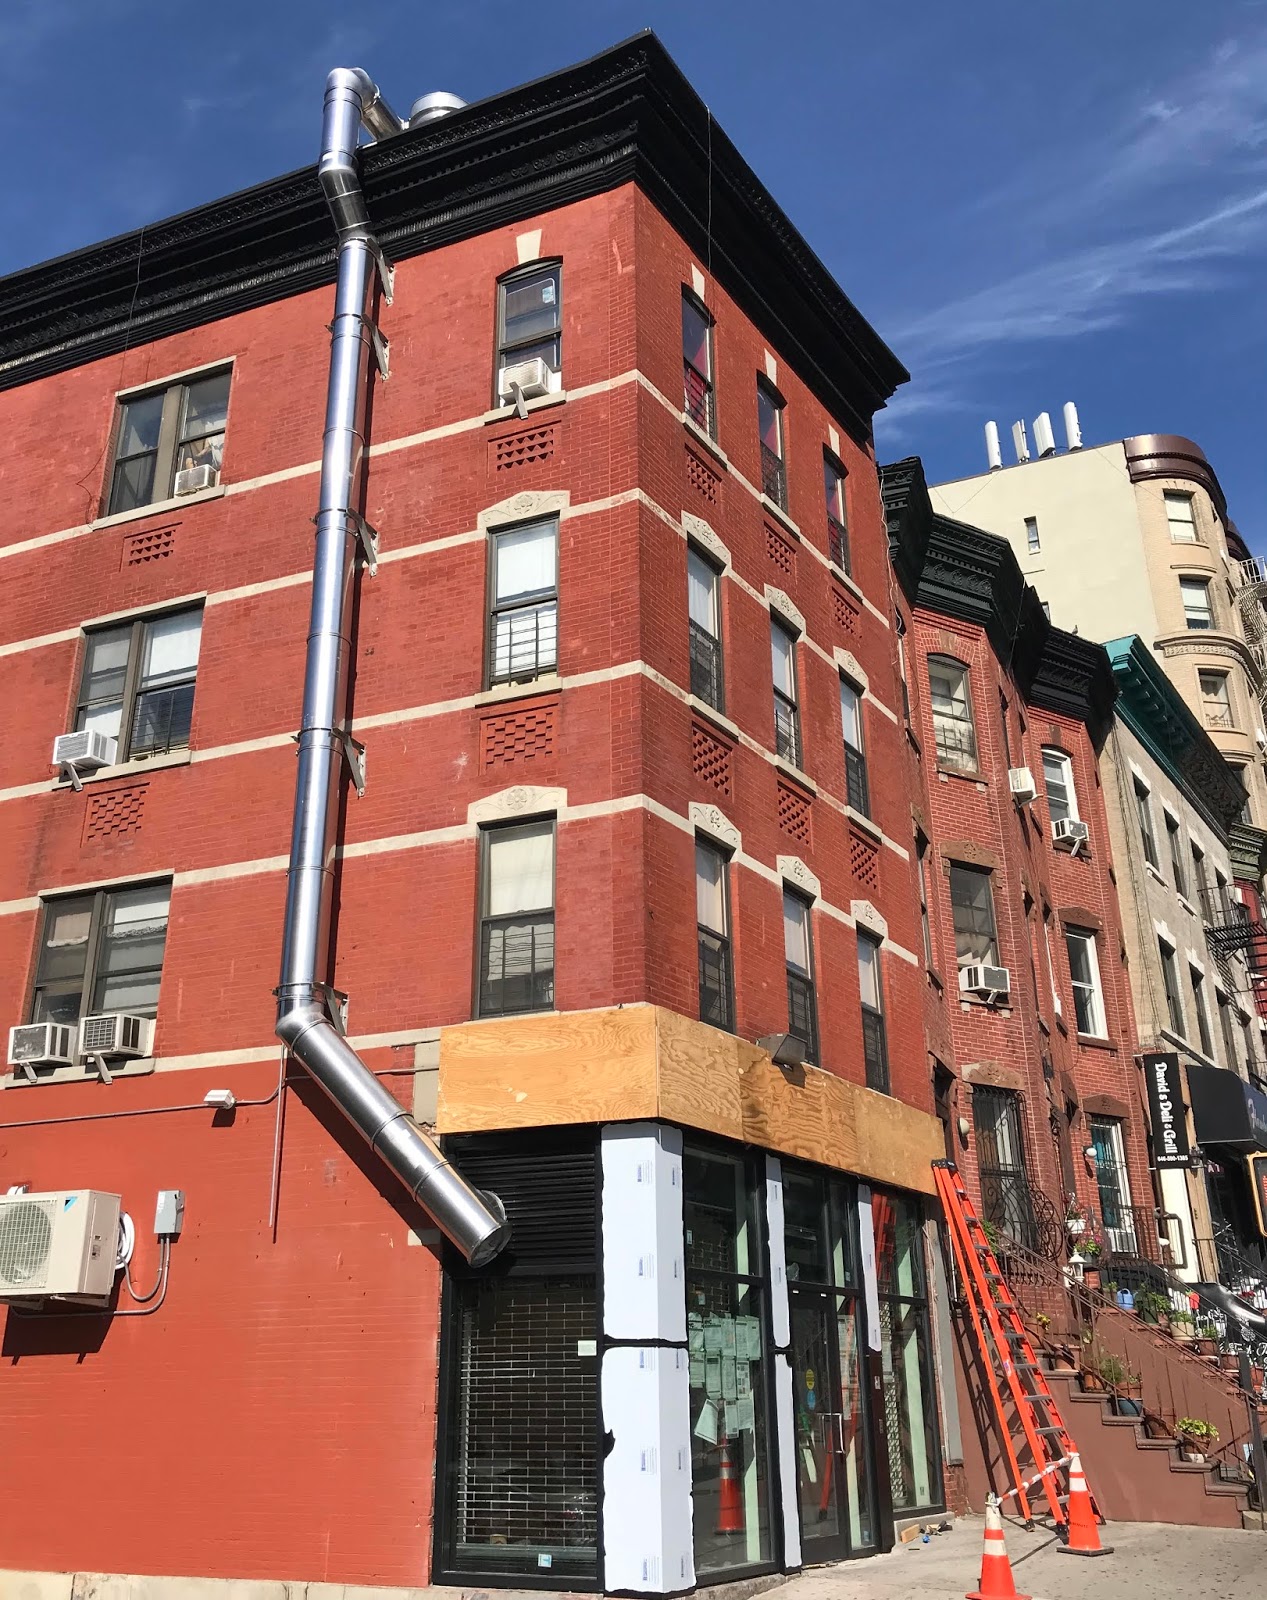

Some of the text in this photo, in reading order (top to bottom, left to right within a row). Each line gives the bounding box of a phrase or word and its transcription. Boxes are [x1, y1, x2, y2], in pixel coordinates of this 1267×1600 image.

[1155, 1062, 1170, 1093] David
[1160, 1101, 1174, 1123] Deli
[1164, 1130, 1178, 1153] Grill
